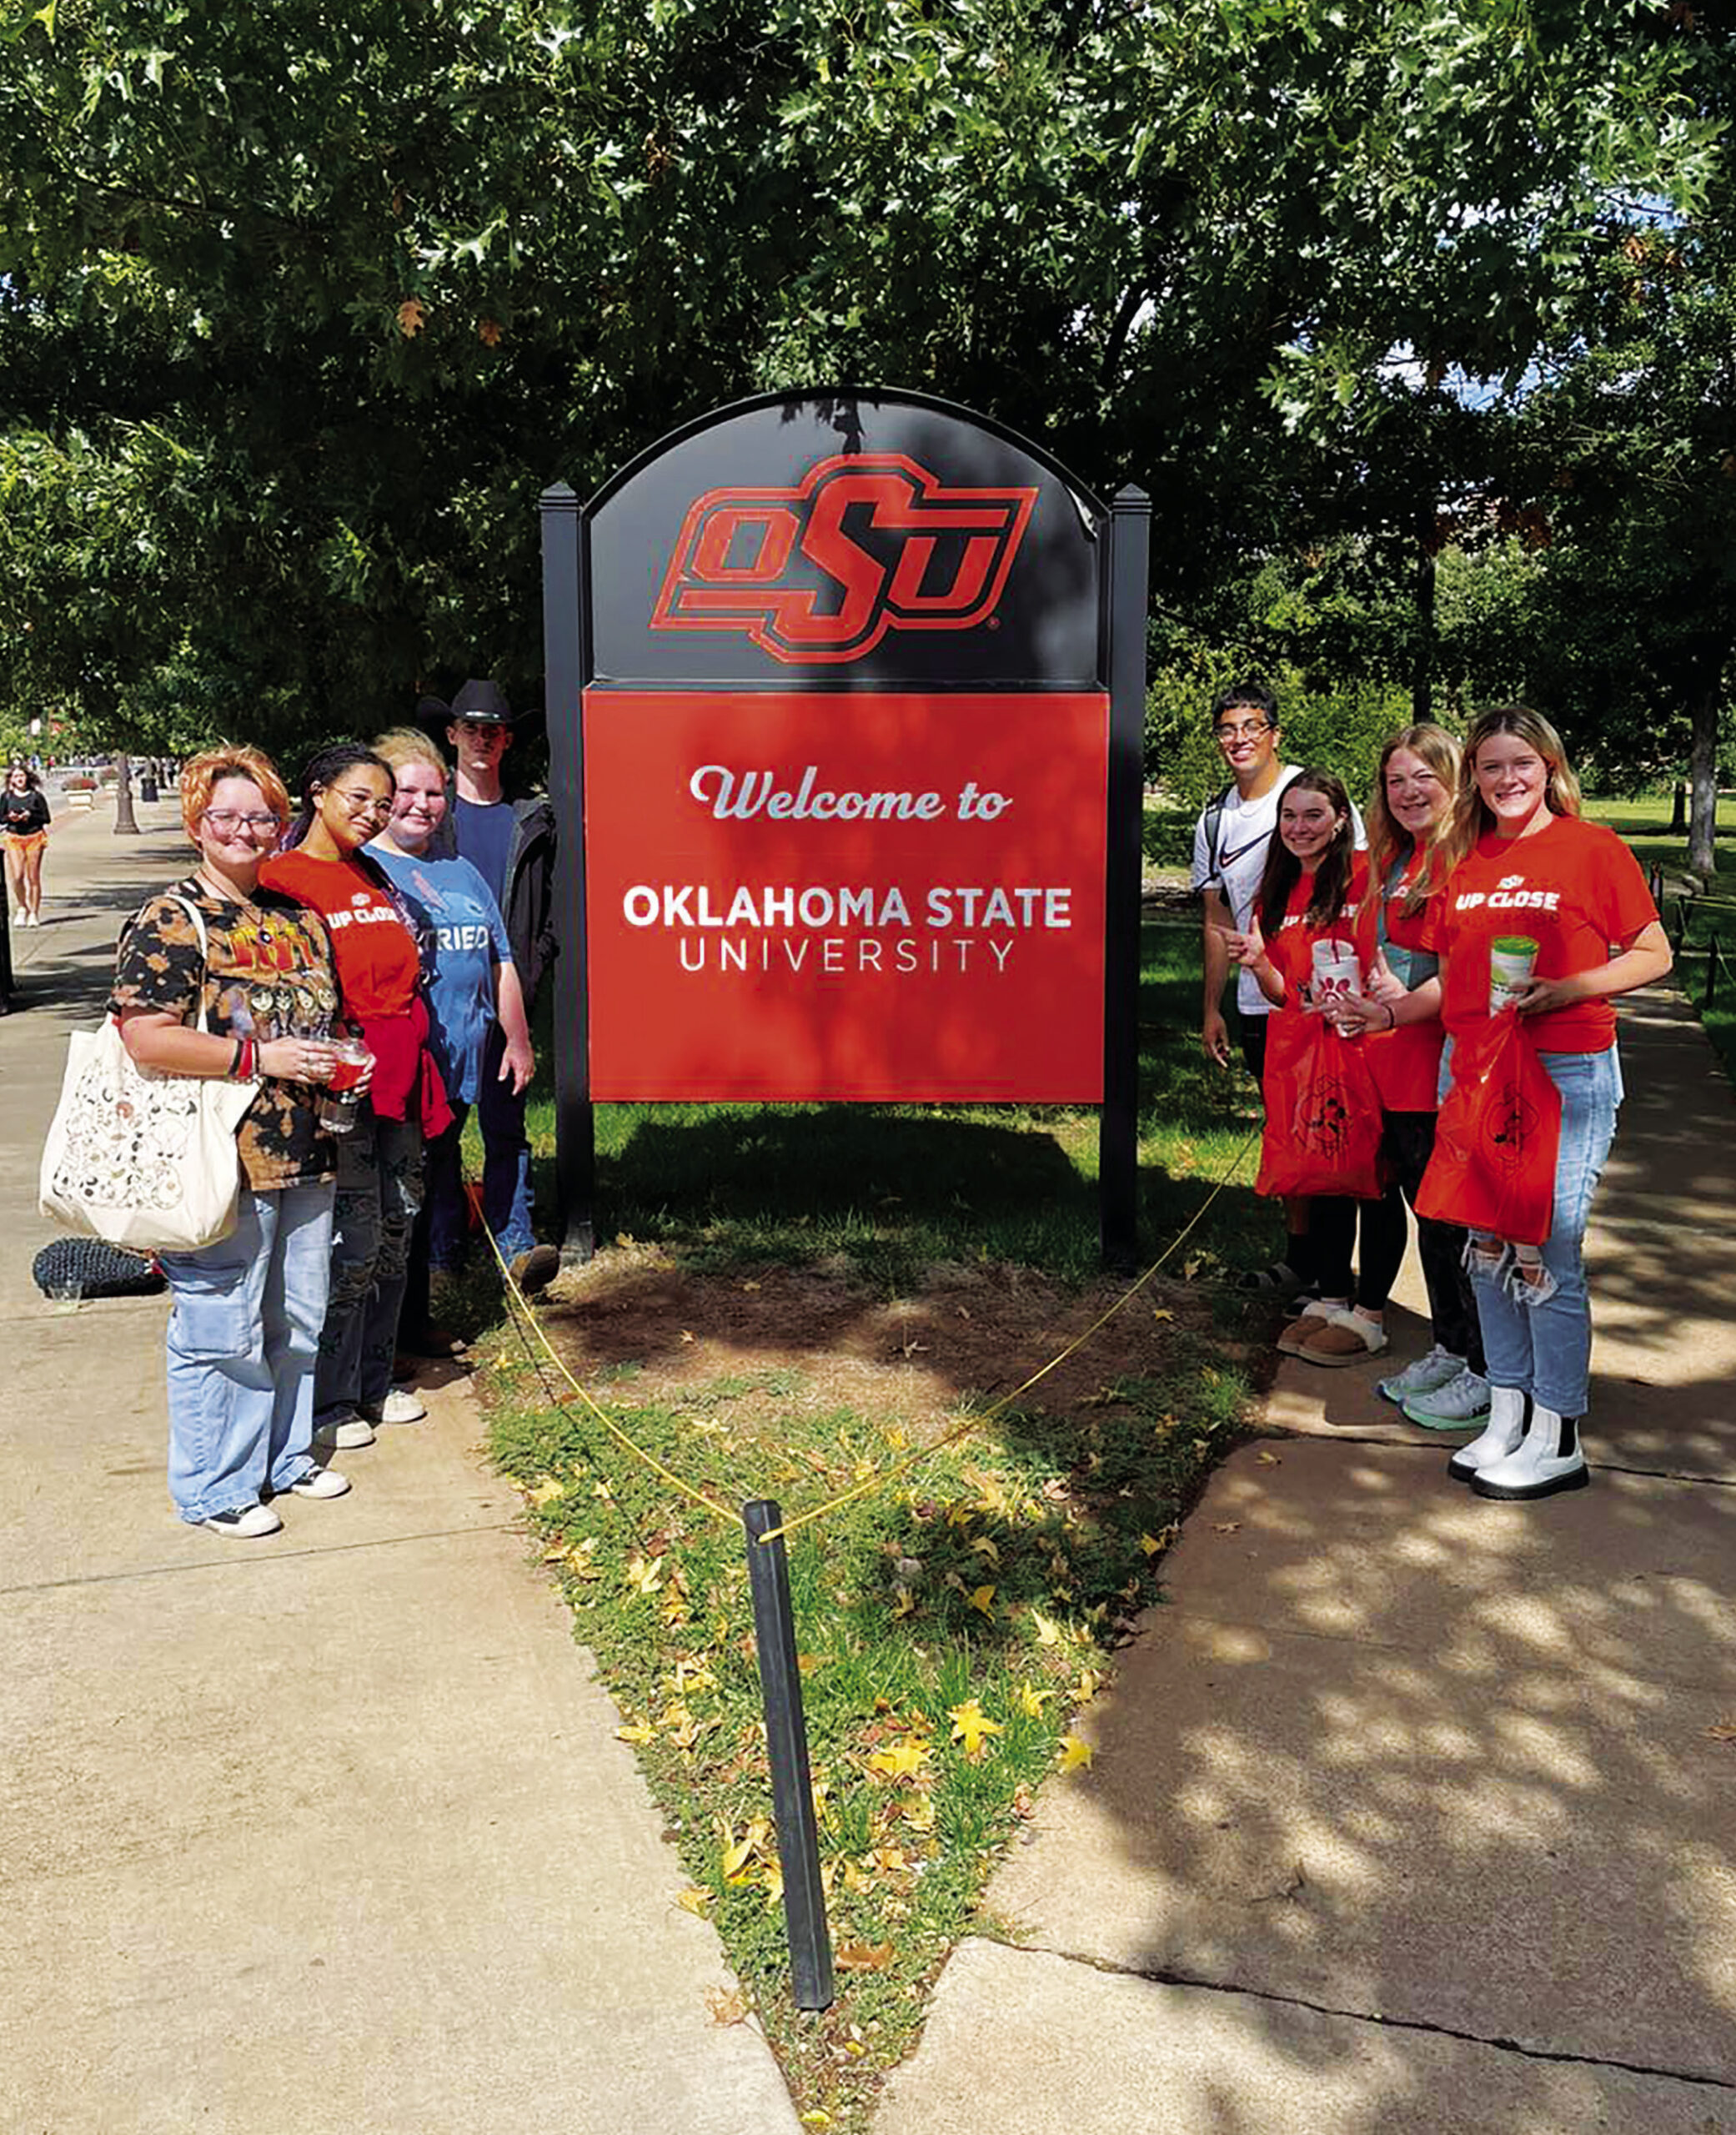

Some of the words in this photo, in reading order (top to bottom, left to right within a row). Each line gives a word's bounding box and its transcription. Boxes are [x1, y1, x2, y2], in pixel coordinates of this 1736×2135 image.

[650, 453, 1039, 664] OSU
[690, 765, 946, 820] Welcome
[957, 782, 1013, 820] to
[326, 910, 354, 929] UP
[354, 906, 400, 923] CLOS
[623, 886, 911, 928] OKLAHOMA
[926, 887, 1072, 928] STATE
[1456, 892, 1485, 911] UP
[1488, 891, 1560, 912] CLOSE
[680, 938, 1014, 972] UNIVERSITY
